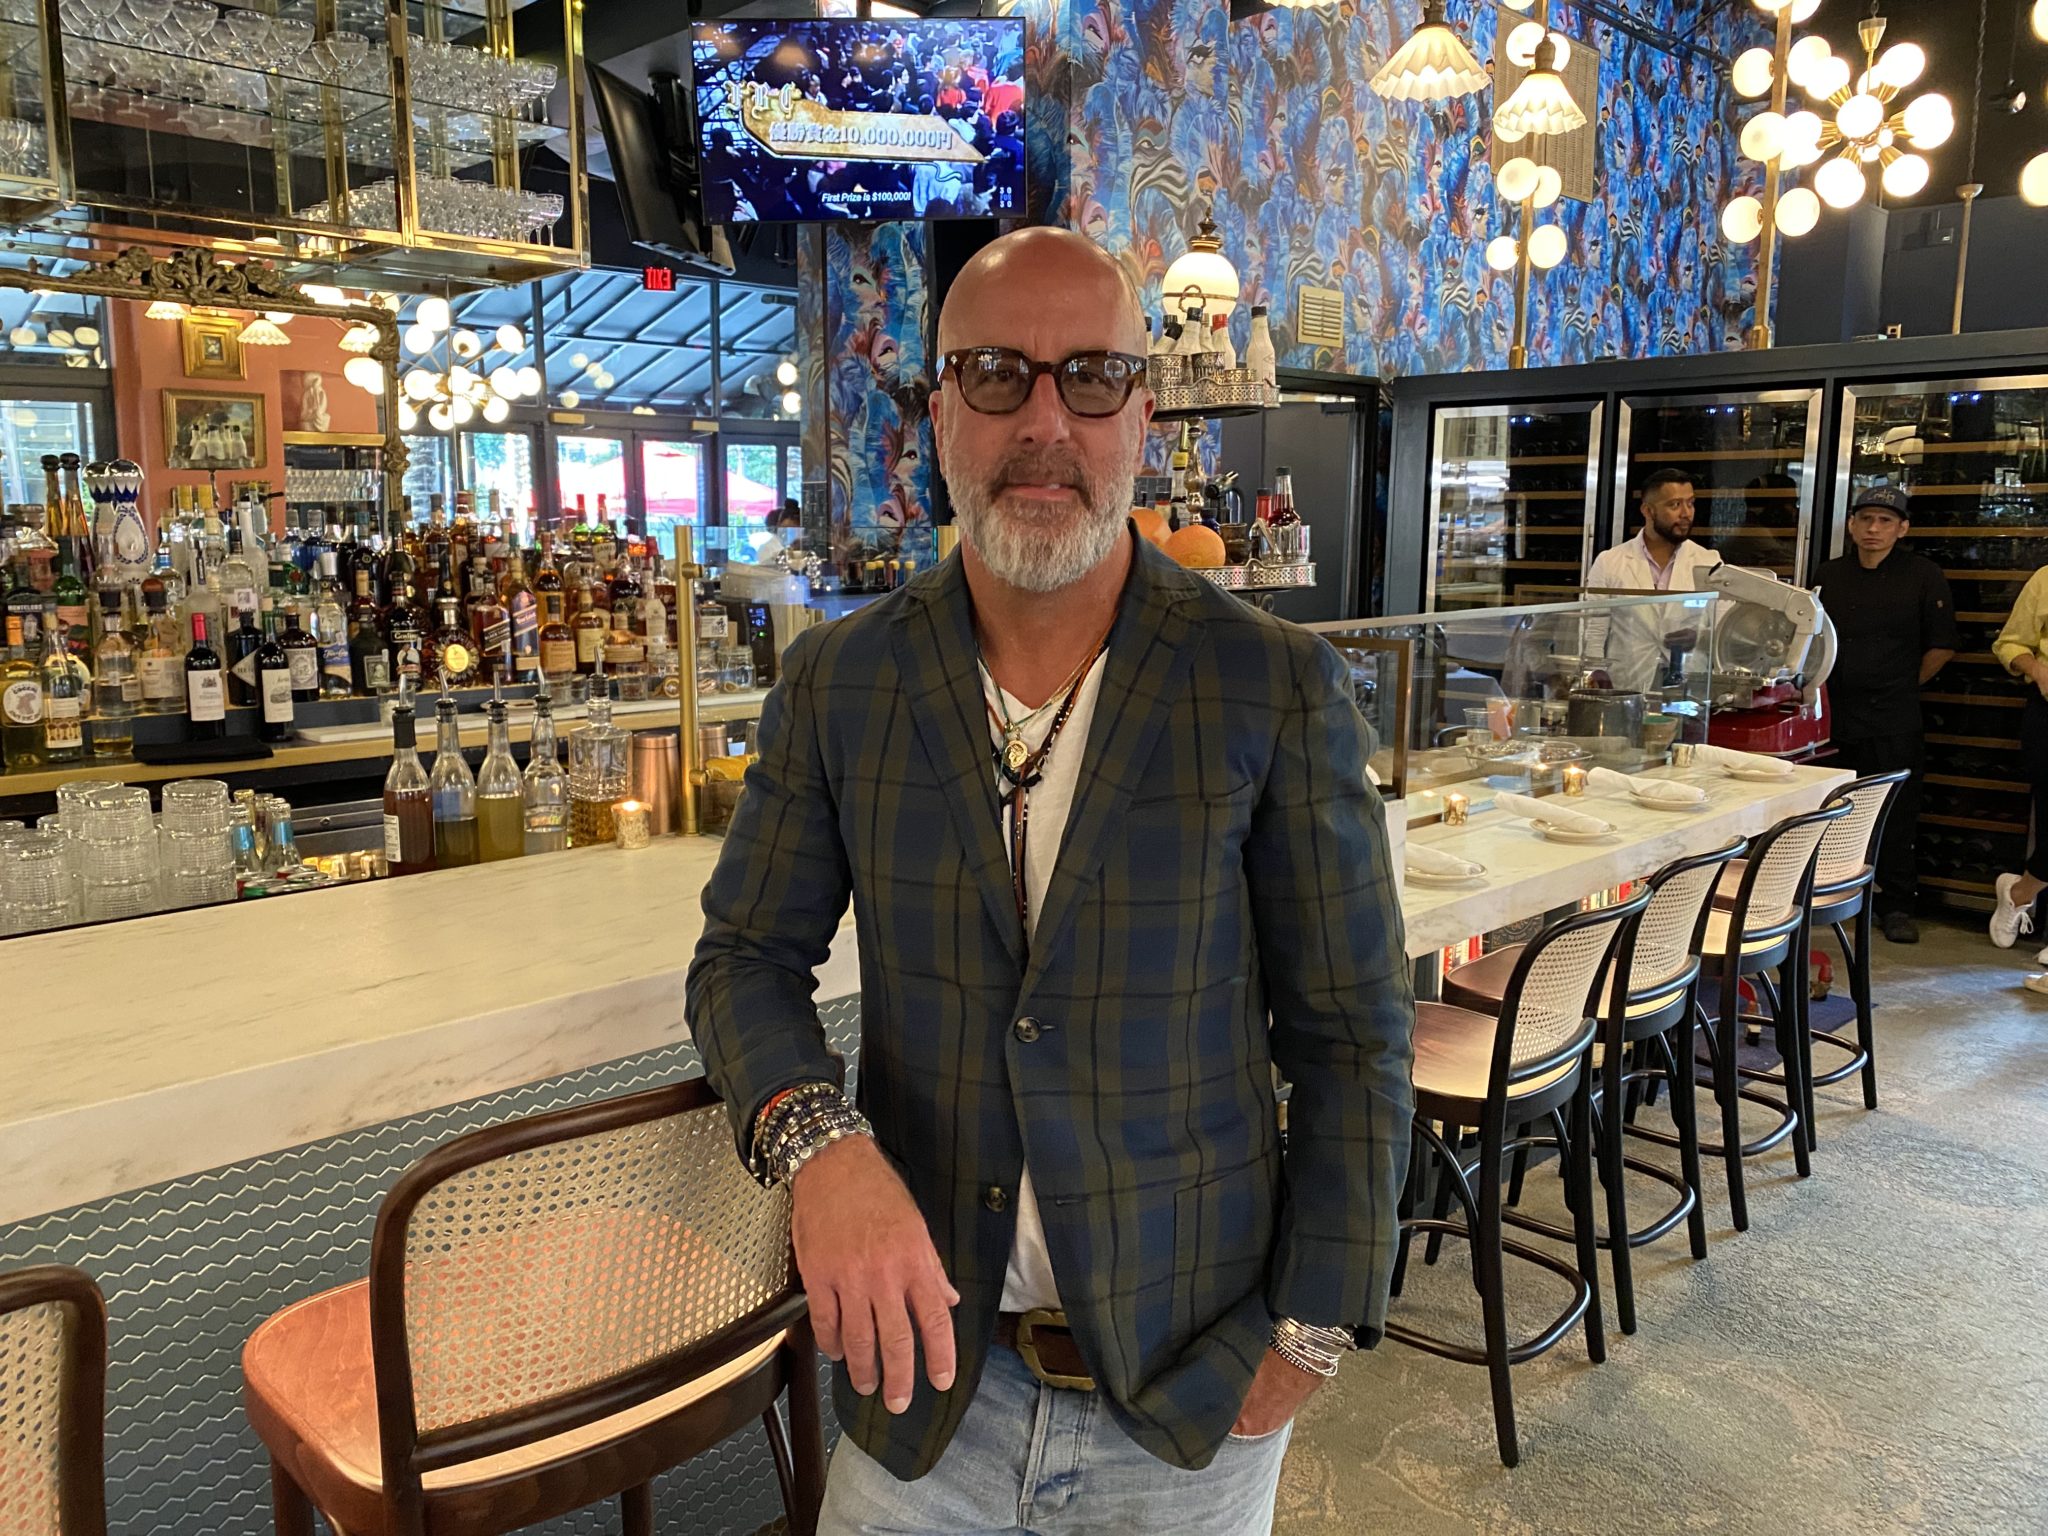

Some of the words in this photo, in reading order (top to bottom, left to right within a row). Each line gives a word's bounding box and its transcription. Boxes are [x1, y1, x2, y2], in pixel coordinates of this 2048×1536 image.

[822, 192, 840, 202] First
[841, 192, 862, 202] Prize
[872, 191, 912, 202] $100,000!
